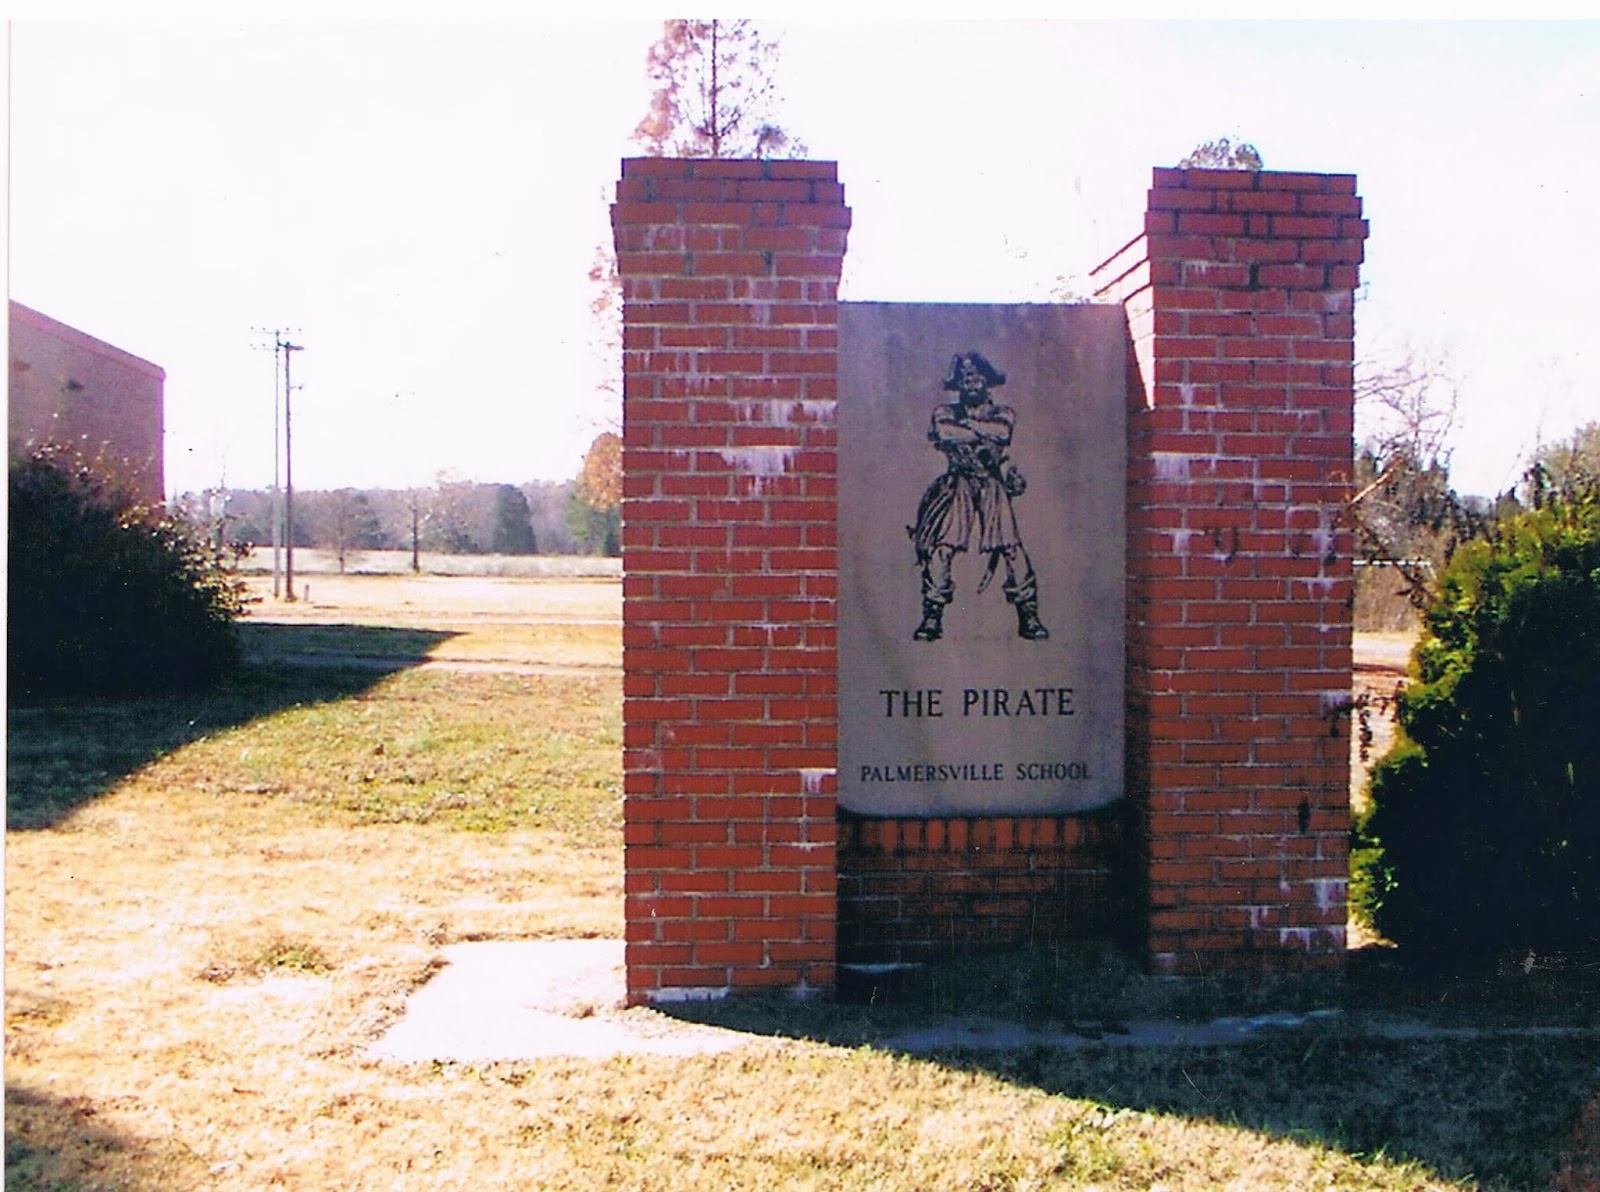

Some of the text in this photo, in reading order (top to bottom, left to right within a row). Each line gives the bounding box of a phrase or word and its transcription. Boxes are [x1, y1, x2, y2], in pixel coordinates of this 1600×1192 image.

[879, 688, 1075, 718] THE PIRATE
[860, 762, 1092, 782] PALMERSVILLE SCHOOL
